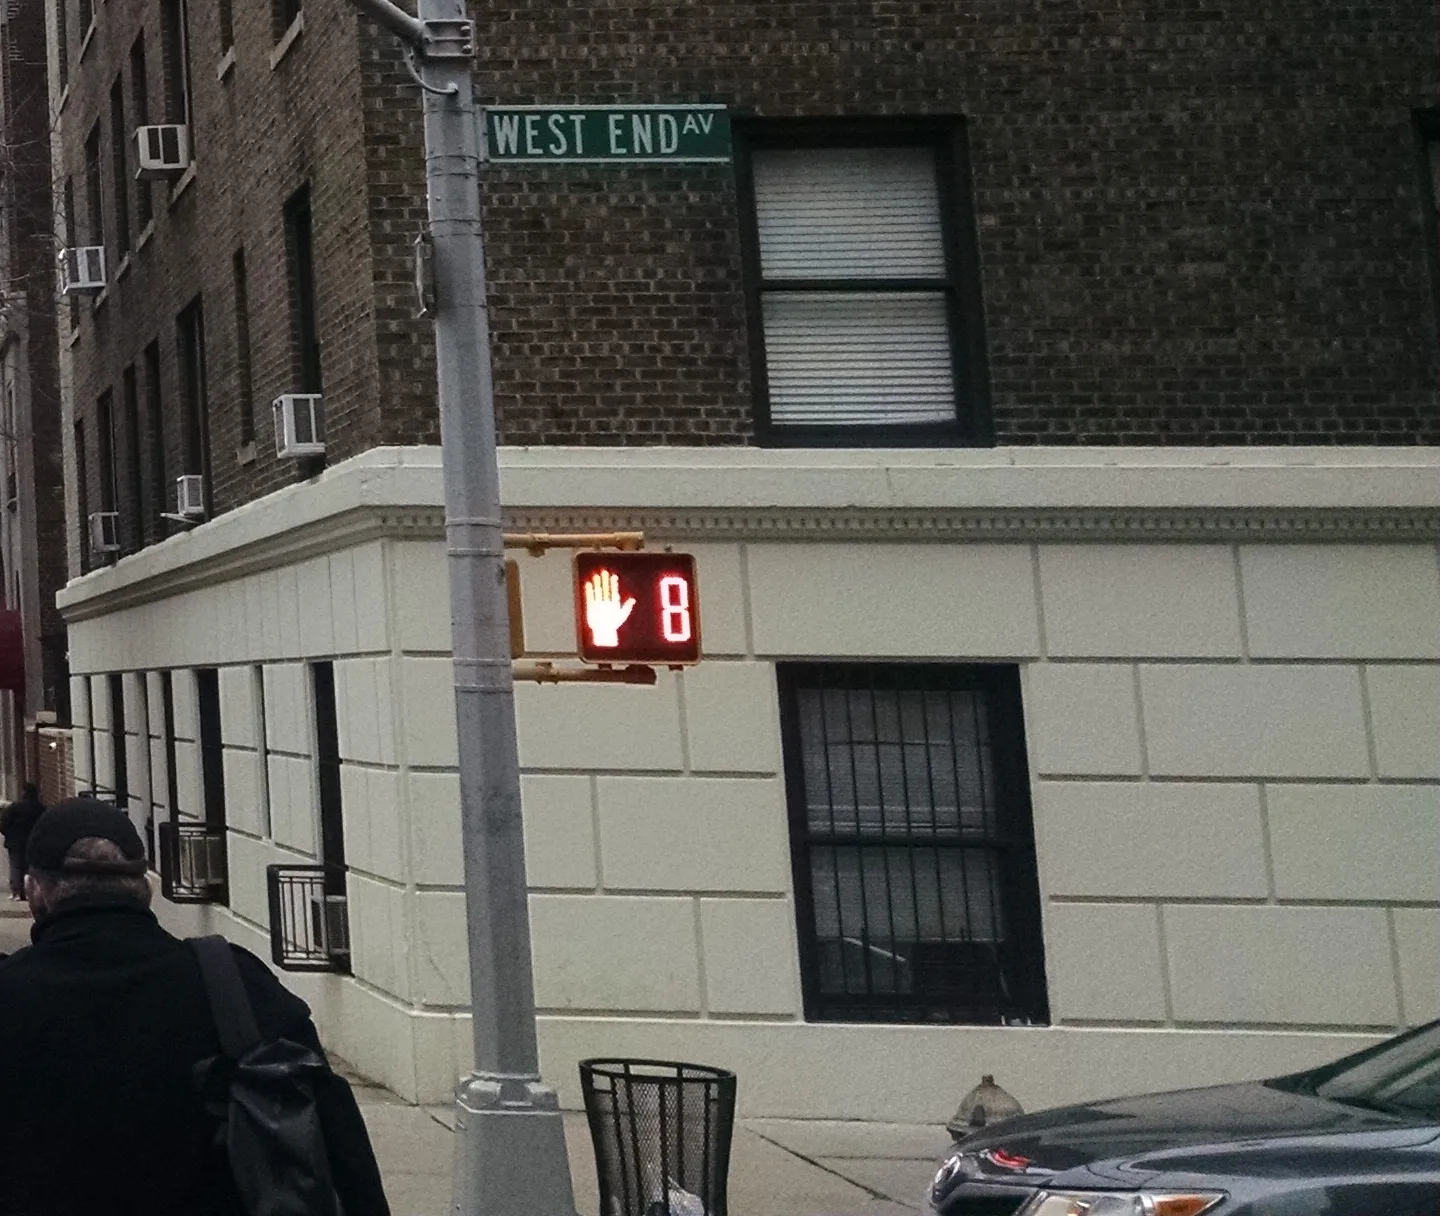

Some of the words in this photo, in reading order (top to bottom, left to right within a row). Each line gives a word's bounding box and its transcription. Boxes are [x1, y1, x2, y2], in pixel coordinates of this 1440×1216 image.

[493, 114, 586, 155] WEST
[608, 113, 679, 155] END
[682, 113, 714, 135] AV
[660, 576, 691, 642] 8
